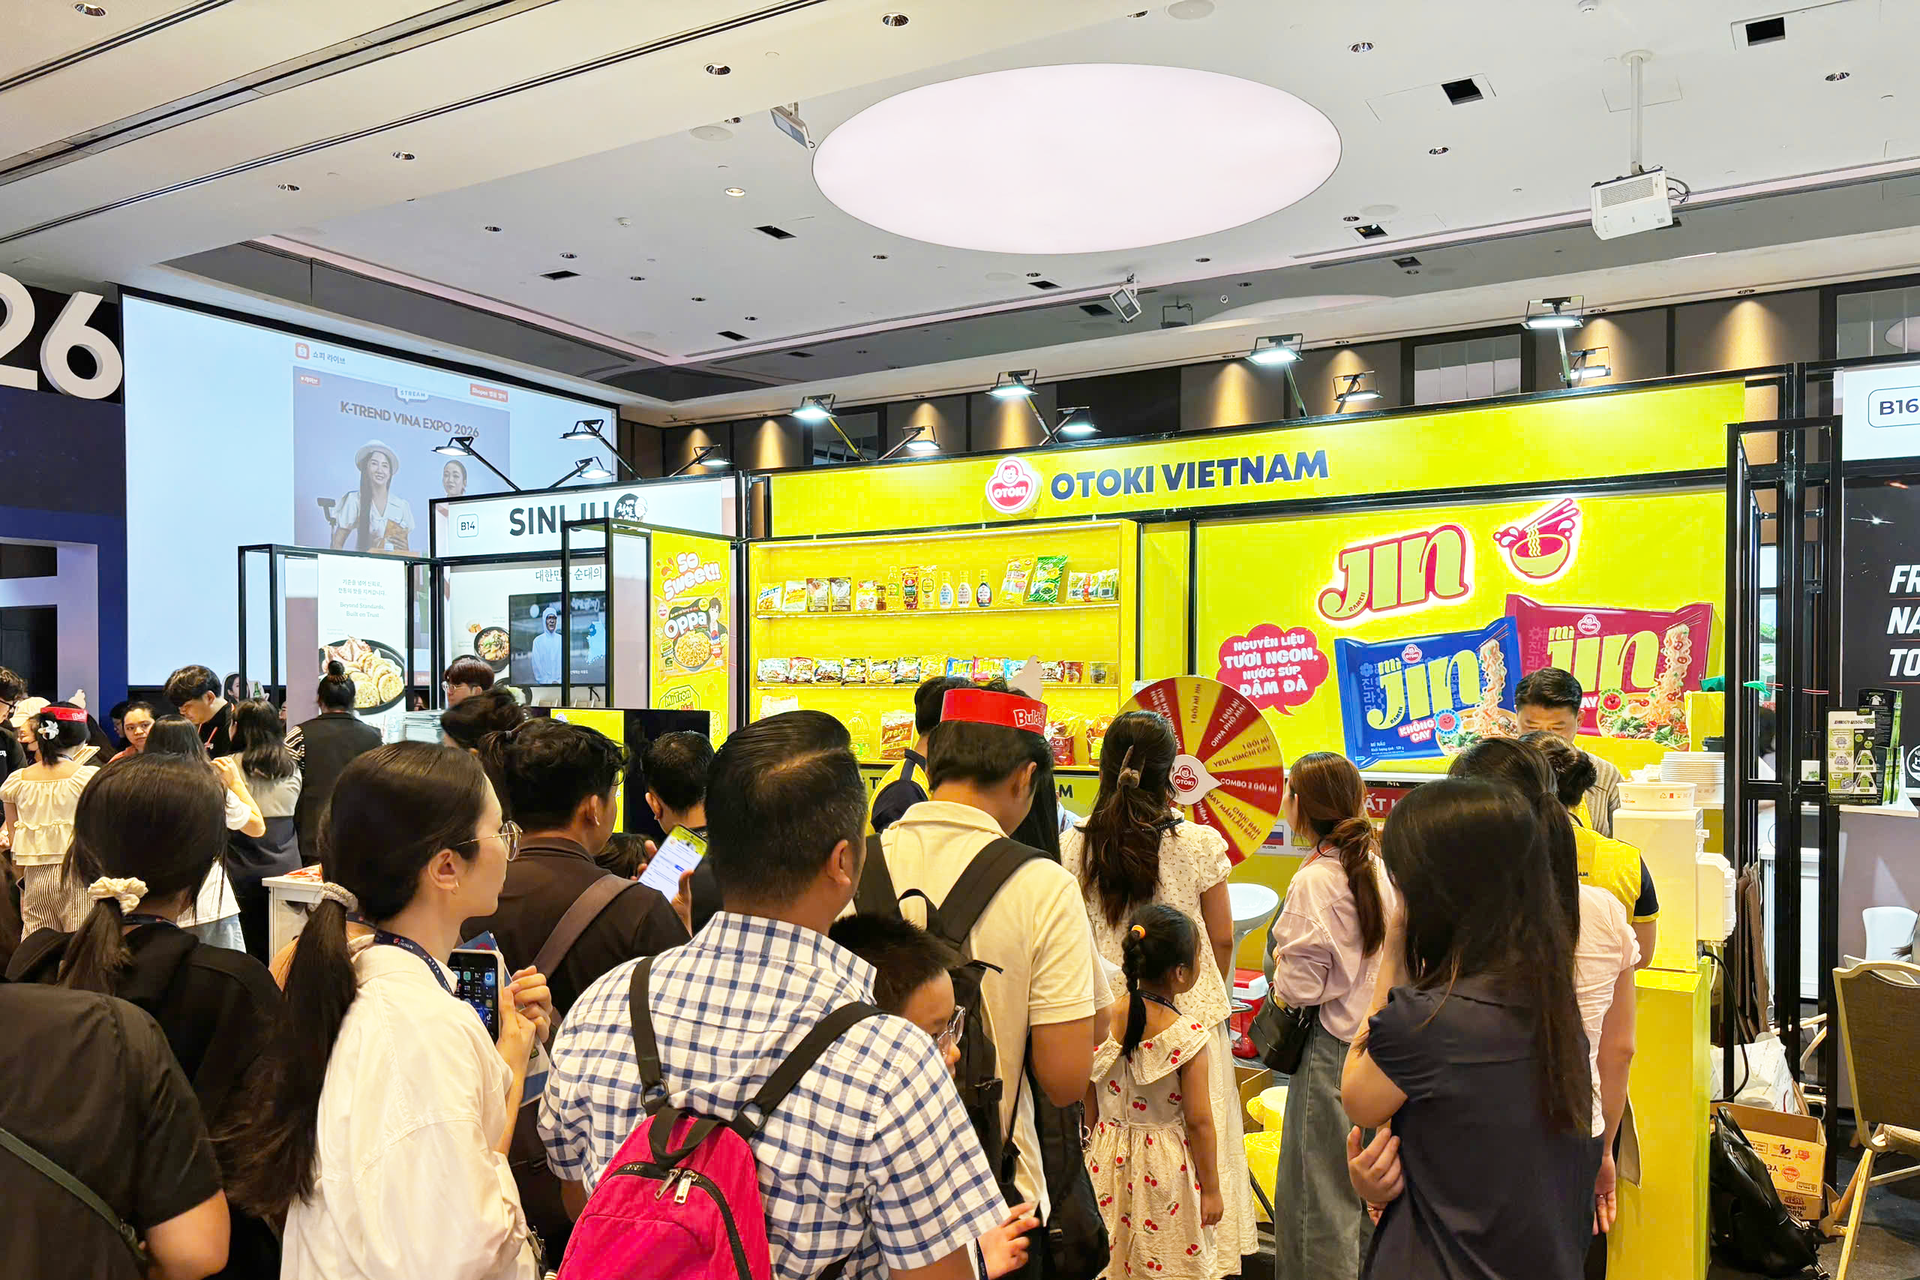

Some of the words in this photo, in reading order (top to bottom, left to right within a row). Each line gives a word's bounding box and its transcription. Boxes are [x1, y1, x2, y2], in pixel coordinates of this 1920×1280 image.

[312, 351, 326, 361] 쇼피
[327, 354, 346, 365] 라이브
[400, 389, 426, 398] STREAM
[1879, 398, 1920, 416] B16
[340, 401, 391, 421] K-TREND
[394, 413, 421, 428] VINA
[423, 418, 452, 433] EXPO
[454, 423, 479, 438] 2026
[1051, 466, 1154, 500] OTOKI
[1162, 450, 1329, 491] VIETNAM
[993, 485, 1026, 499] OTOKI
[460, 521, 475, 531] B14
[535, 567, 572, 582] 대한민
[340, 601, 358, 609] Beyond
[1233, 636, 1278, 652] NGUYÊN
[1281, 633, 1305, 647] LIỆU
[1224, 651, 1262, 669] TƯƠI
[1265, 647, 1319, 665] NGON,
[1242, 666, 1275, 680] NƯỚC
[1278, 664, 1301, 677] SÚP
[1239, 679, 1279, 698] ĐẬM
[1283, 675, 1308, 693] ĐÀ
[1400, 719, 1435, 736] KHÔNG
[1411, 729, 1431, 741] CAY
[1211, 731, 1227, 747] OPPA
[1213, 758, 1232, 768] YEUL
[1232, 750, 1257, 762] KIMCHI
[1176, 777, 1194, 786] OTOKI
[1220, 777, 1247, 788] COMBO
[1253, 782, 1267, 791] GÓI
[1267, 783, 1278, 793] MÌ
[1206, 792, 1220, 805] MAY
